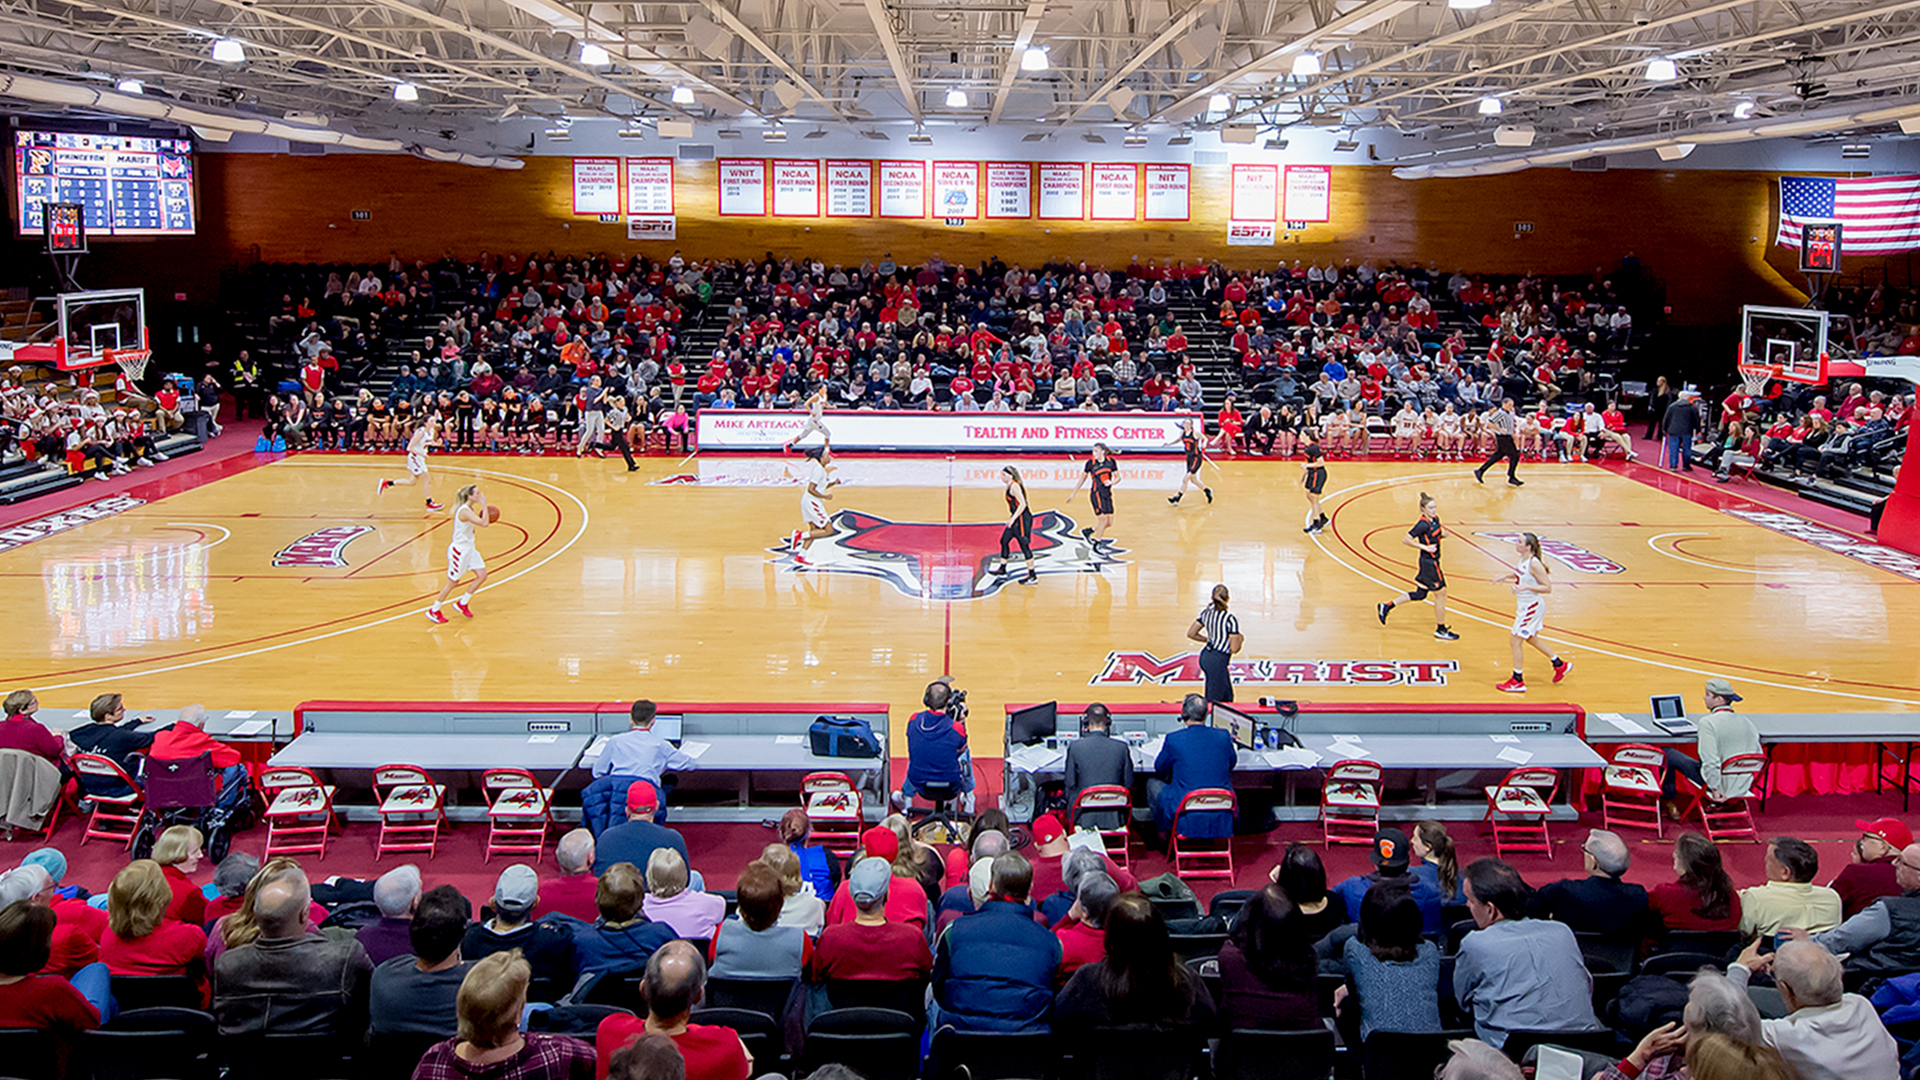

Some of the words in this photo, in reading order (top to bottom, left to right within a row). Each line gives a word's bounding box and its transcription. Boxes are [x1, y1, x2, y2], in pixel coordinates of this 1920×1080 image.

[59, 153, 105, 161] PRINCETON
[117, 156, 150, 164] MARIST
[729, 169, 755, 177] WNIT
[889, 171, 916, 179] NCAA
[631, 220, 672, 231] ESPN
[54, 223, 76, 247] 29
[1231, 226, 1271, 237] ESPN
[1809, 242, 1832, 266] 29
[714, 420, 744, 428] MIKE
[747, 420, 804, 428] ARTEAGA'S
[1021, 427, 1049, 439] AND
[1055, 426, 1108, 439] FITNESS
[1112, 426, 1165, 439] CENTER
[1089, 650, 1461, 686] MARIST
